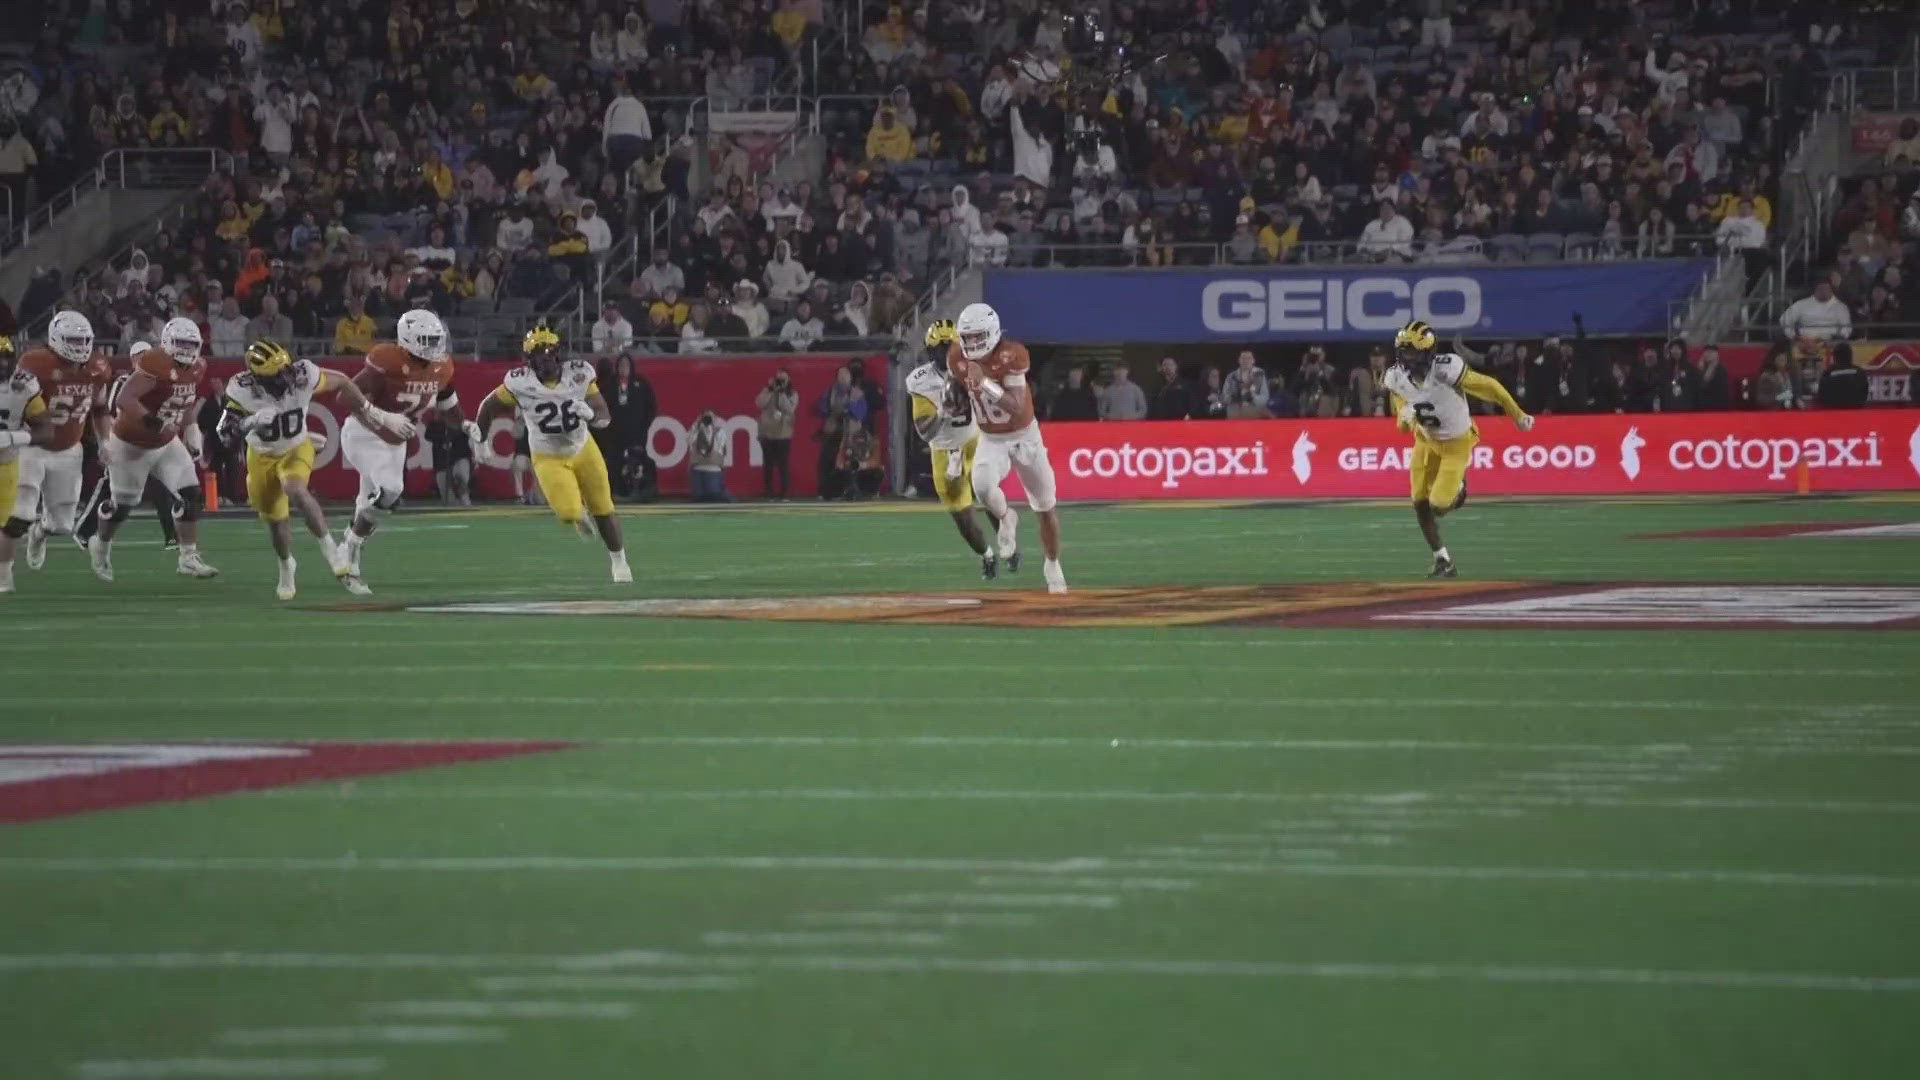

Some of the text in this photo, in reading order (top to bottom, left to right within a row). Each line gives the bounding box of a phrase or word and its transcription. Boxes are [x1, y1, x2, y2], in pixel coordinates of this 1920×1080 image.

[1201, 276, 1482, 332] GEICO
[57, 383, 94, 395] TEXAS
[404, 381, 440, 393] TEXAS
[1867, 374, 1912, 401] HEEZ
[49, 394, 92, 424] 54
[535, 399, 580, 434] 26
[1413, 402, 1441, 427] 6
[1069, 441, 1268, 488] cotopaxi
[1502, 445, 1596, 469] GOOD
[1669, 431, 1882, 480] cotopaxi
